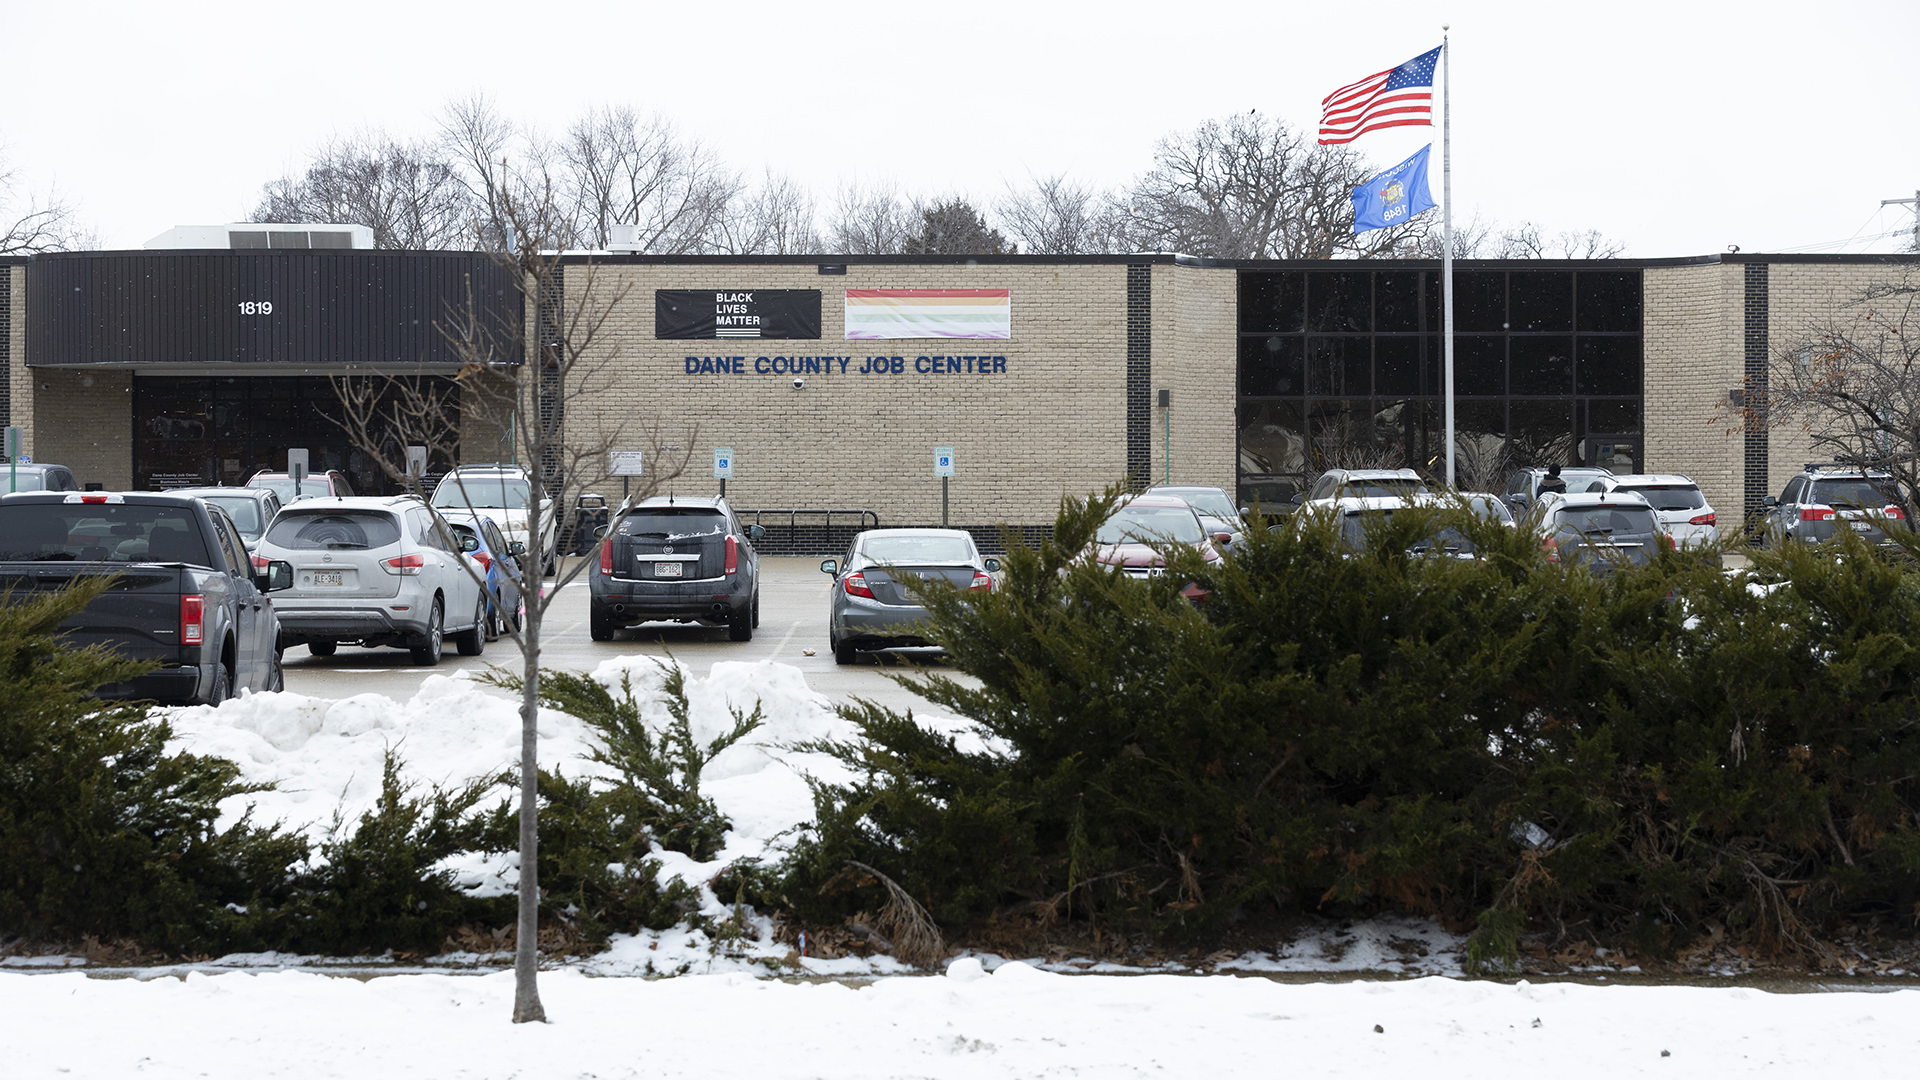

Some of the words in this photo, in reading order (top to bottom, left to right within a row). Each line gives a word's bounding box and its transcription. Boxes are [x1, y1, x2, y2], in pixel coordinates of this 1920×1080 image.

[716, 293, 753, 303] BLACK
[238, 301, 273, 315] 1819
[716, 304, 748, 314] LIVES
[716, 316, 760, 325] MATTER
[685, 356, 745, 374] DANE
[754, 356, 851, 374] COUNTY
[860, 356, 905, 374] JOB
[915, 356, 1007, 374] CENTER
[314, 575, 343, 583] ALE-3418
